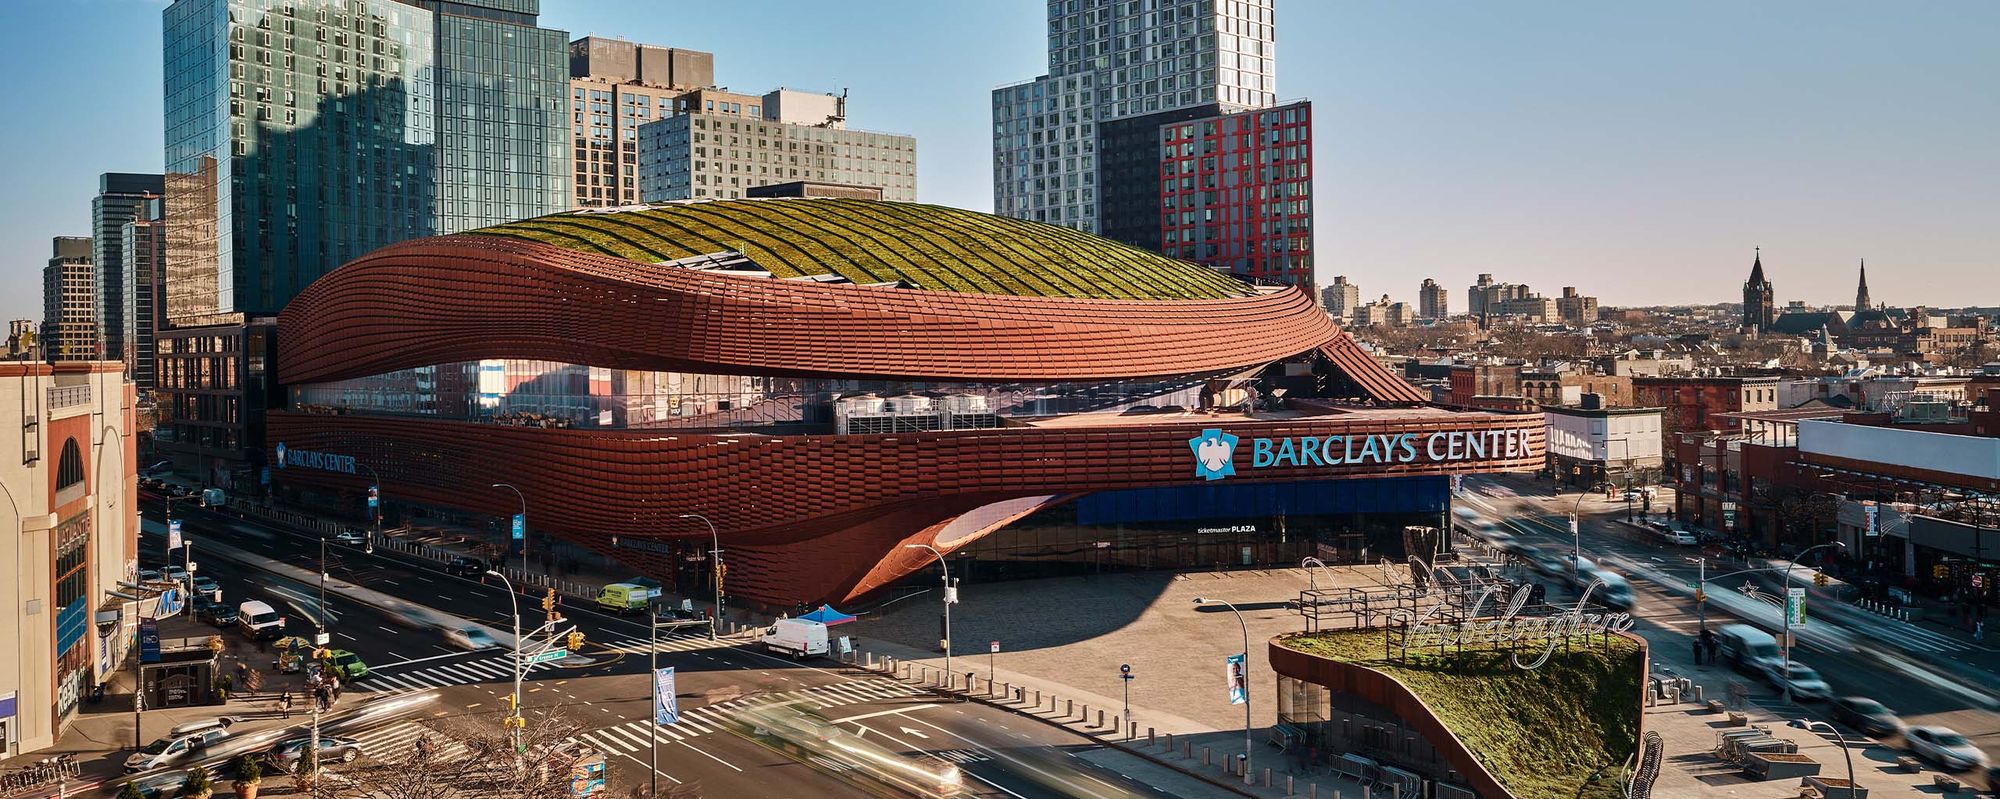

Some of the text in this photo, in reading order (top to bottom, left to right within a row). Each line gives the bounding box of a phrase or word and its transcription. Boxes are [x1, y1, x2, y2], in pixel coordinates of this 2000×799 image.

[287, 448, 356, 474] BARCLAYS CENTER
[1253, 429, 1533, 468] BARCLAYS CENTER
[1231, 525, 1256, 533] PLAZA
